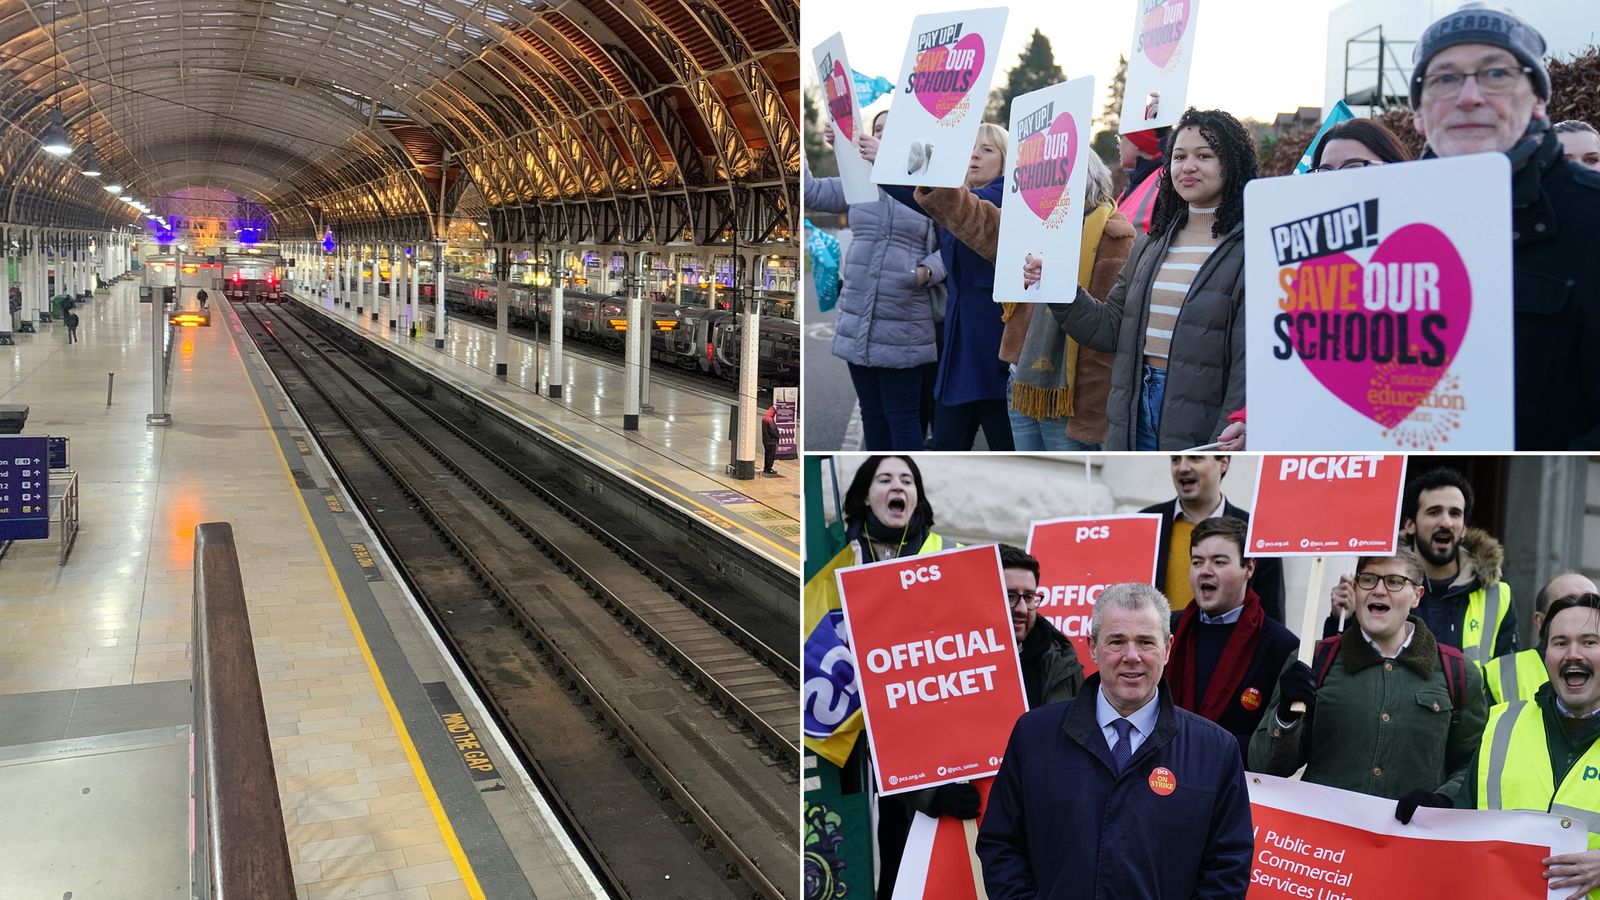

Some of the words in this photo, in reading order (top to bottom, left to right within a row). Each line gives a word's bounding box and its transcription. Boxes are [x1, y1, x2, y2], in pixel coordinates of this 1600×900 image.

[919, 31, 939, 51] PAY
[939, 23, 963, 44] UP!
[913, 50, 947, 73] SAVE
[945, 49, 976, 70] OUR
[905, 70, 972, 94] SCHOOLS
[1018, 114, 1034, 141] PAY
[1034, 101, 1054, 130] UP!
[1016, 135, 1045, 167] SAVE
[1044, 132, 1069, 160] OUR
[1012, 158, 1069, 194] SCHOOLS
[1273, 216, 1320, 262] PAY
[1323, 198, 1379, 250] UP!
[1278, 264, 1358, 312] SAVE
[1363, 261, 1440, 313] OUR
[1273, 312, 1448, 368] SCHOOLS
[1367, 384, 1466, 410] education
[1279, 455, 1384, 481] PICKET
[1075, 525, 1110, 543] pcs
[900, 564, 942, 590] pcs
[1036, 584, 1109, 608] OFFIC
[866, 628, 1005, 674] OFFICIAL
[885, 665, 997, 709] PICKET
[453, 733, 481, 751] THE
[464, 751, 493, 771] GAP
[948, 763, 979, 773] @pcs_union
[1583, 765, 1600, 781] p
[899, 773, 926, 783] pcs.org.uk
[1151, 780, 1174, 789] STRIKE
[1264, 830, 1312, 856] Public
[1313, 849, 1345, 864] and
[1258, 850, 1353, 887] Commercial
[1250, 868, 1315, 899] Services
